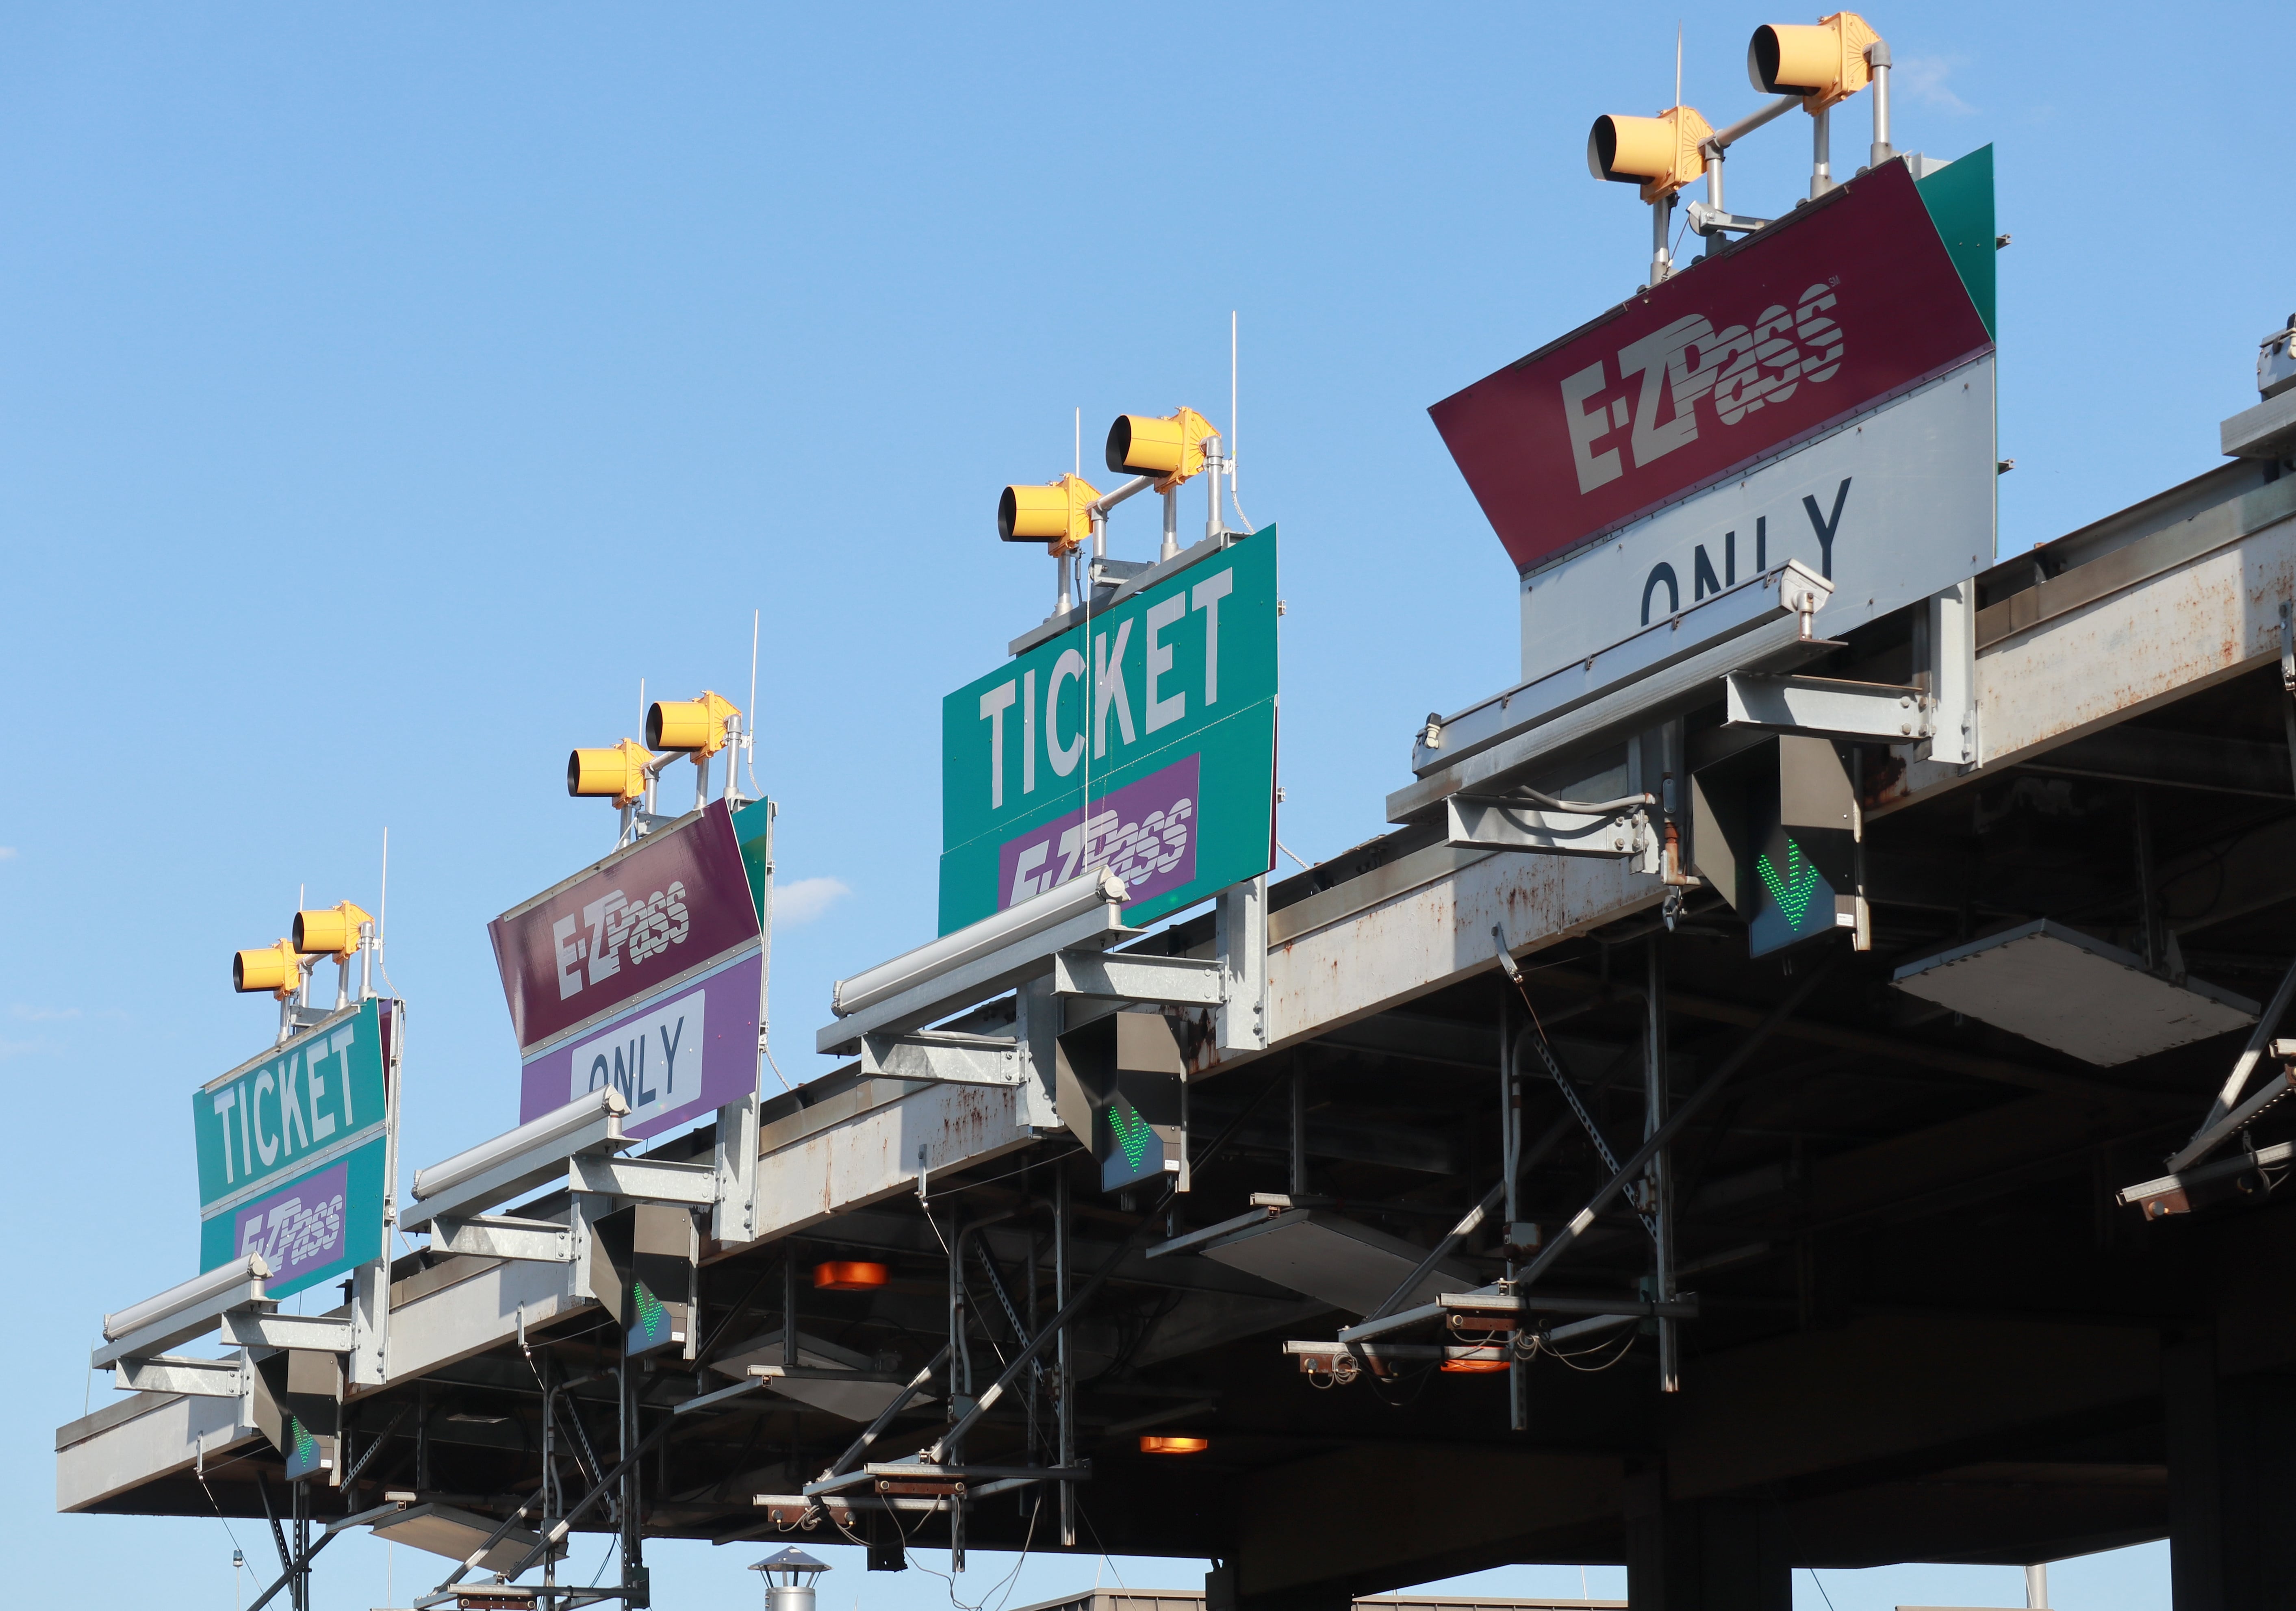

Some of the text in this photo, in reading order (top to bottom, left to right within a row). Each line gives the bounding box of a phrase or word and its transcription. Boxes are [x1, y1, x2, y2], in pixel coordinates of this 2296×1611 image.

[980, 567, 1233, 810] TICKET
[552, 881, 690, 1001] E-ZPass
[214, 1023, 354, 1185] TICKET
[589, 1016, 685, 1111] ONLY
